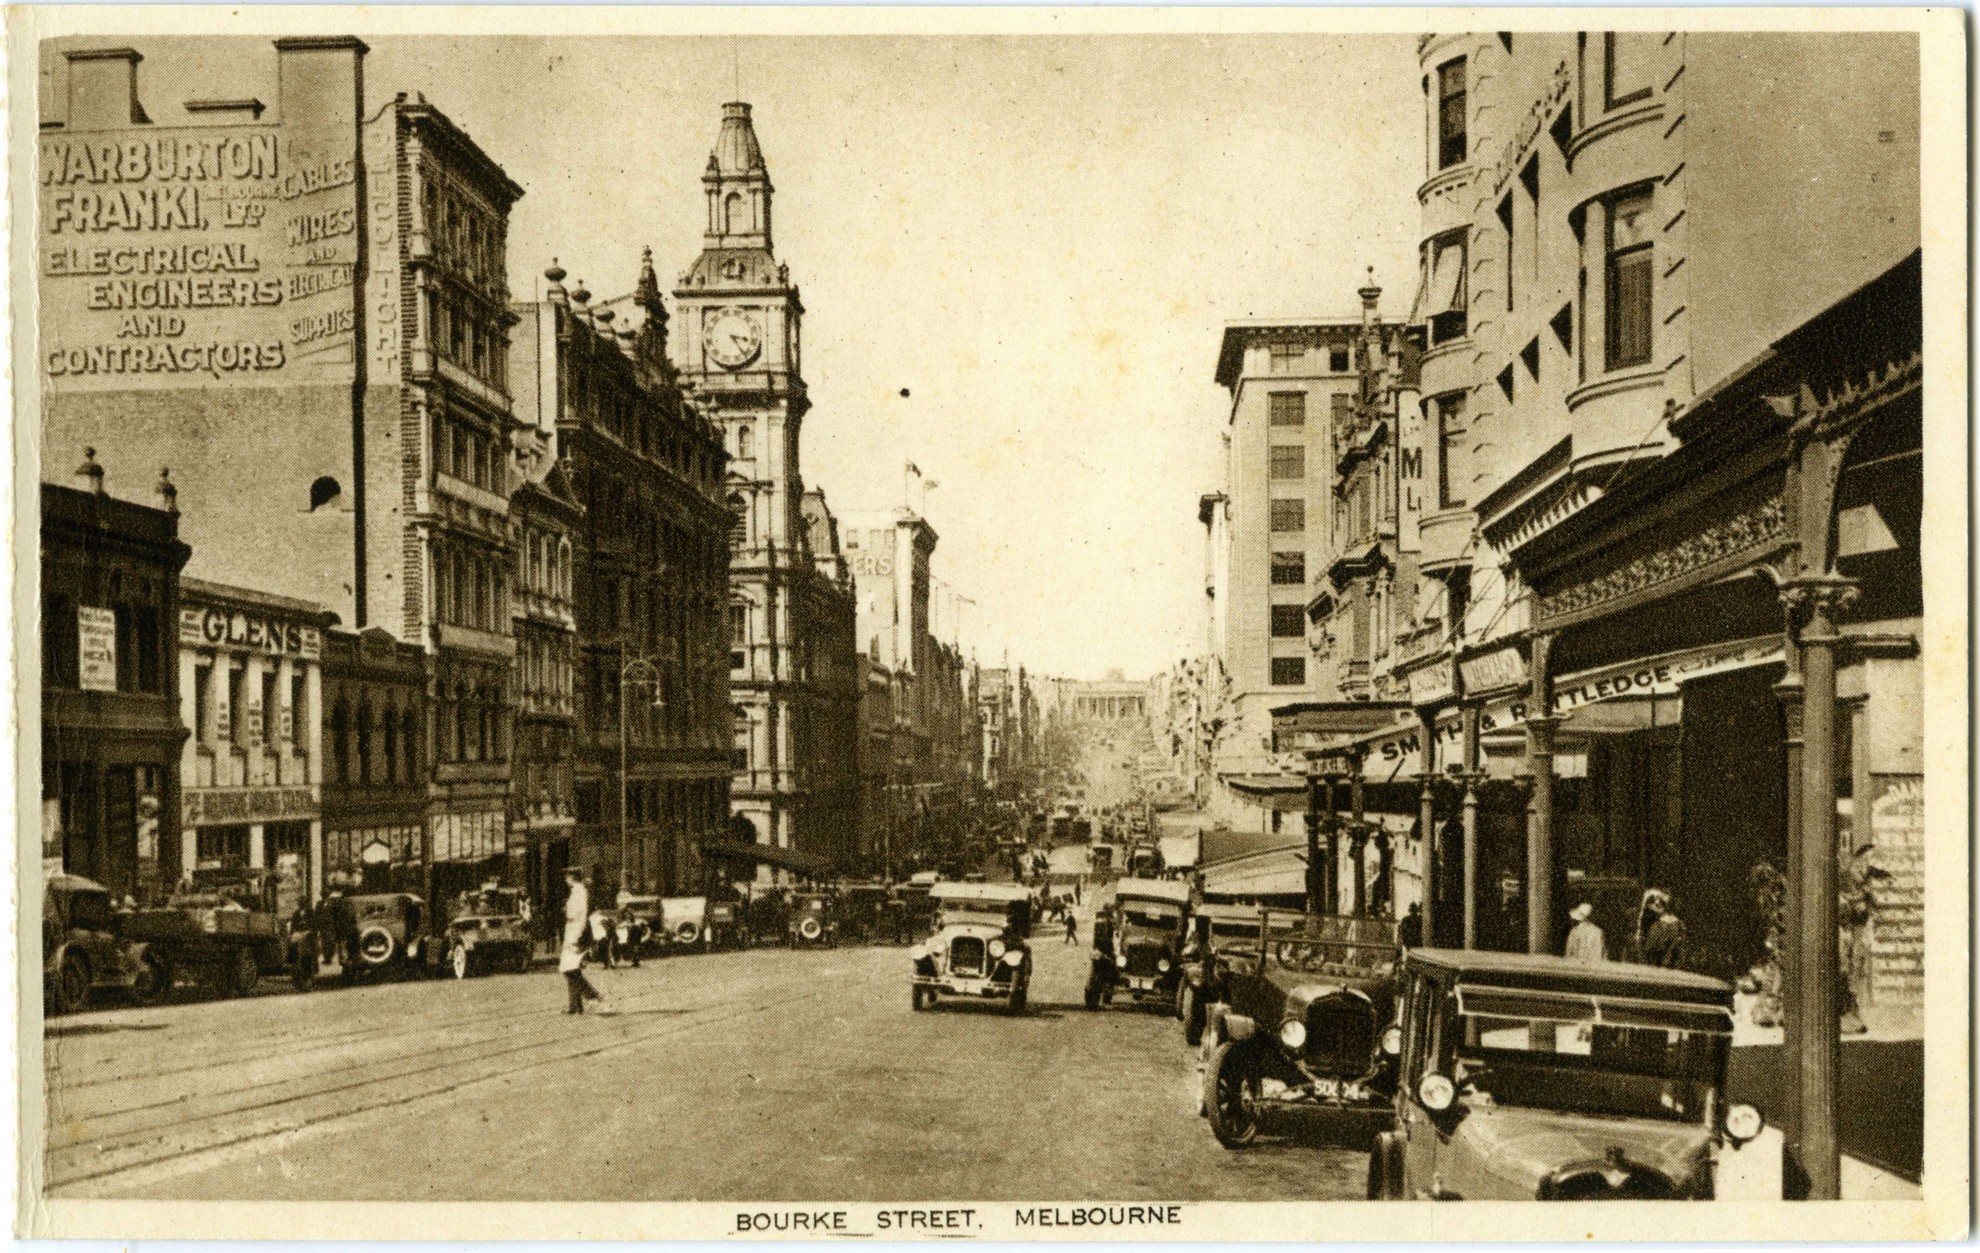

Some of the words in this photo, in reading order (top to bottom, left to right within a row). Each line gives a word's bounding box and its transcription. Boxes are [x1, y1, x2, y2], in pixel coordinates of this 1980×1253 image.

[40, 134, 278, 186] WARBURTON
[283, 160, 355, 200] CABLES
[286, 207, 355, 248] WIRES
[46, 243, 260, 276] ELECTRICAL
[87, 276, 283, 310] ENGINEERS
[117, 314, 186, 339] AND
[48, 340, 287, 376] CONTRACTORS
[203, 610, 301, 653] GLENS
[1380, 720, 1463, 761] SMTH
[1481, 713, 1497, 731] &
[1509, 664, 1673, 722] RTTLEDGE
